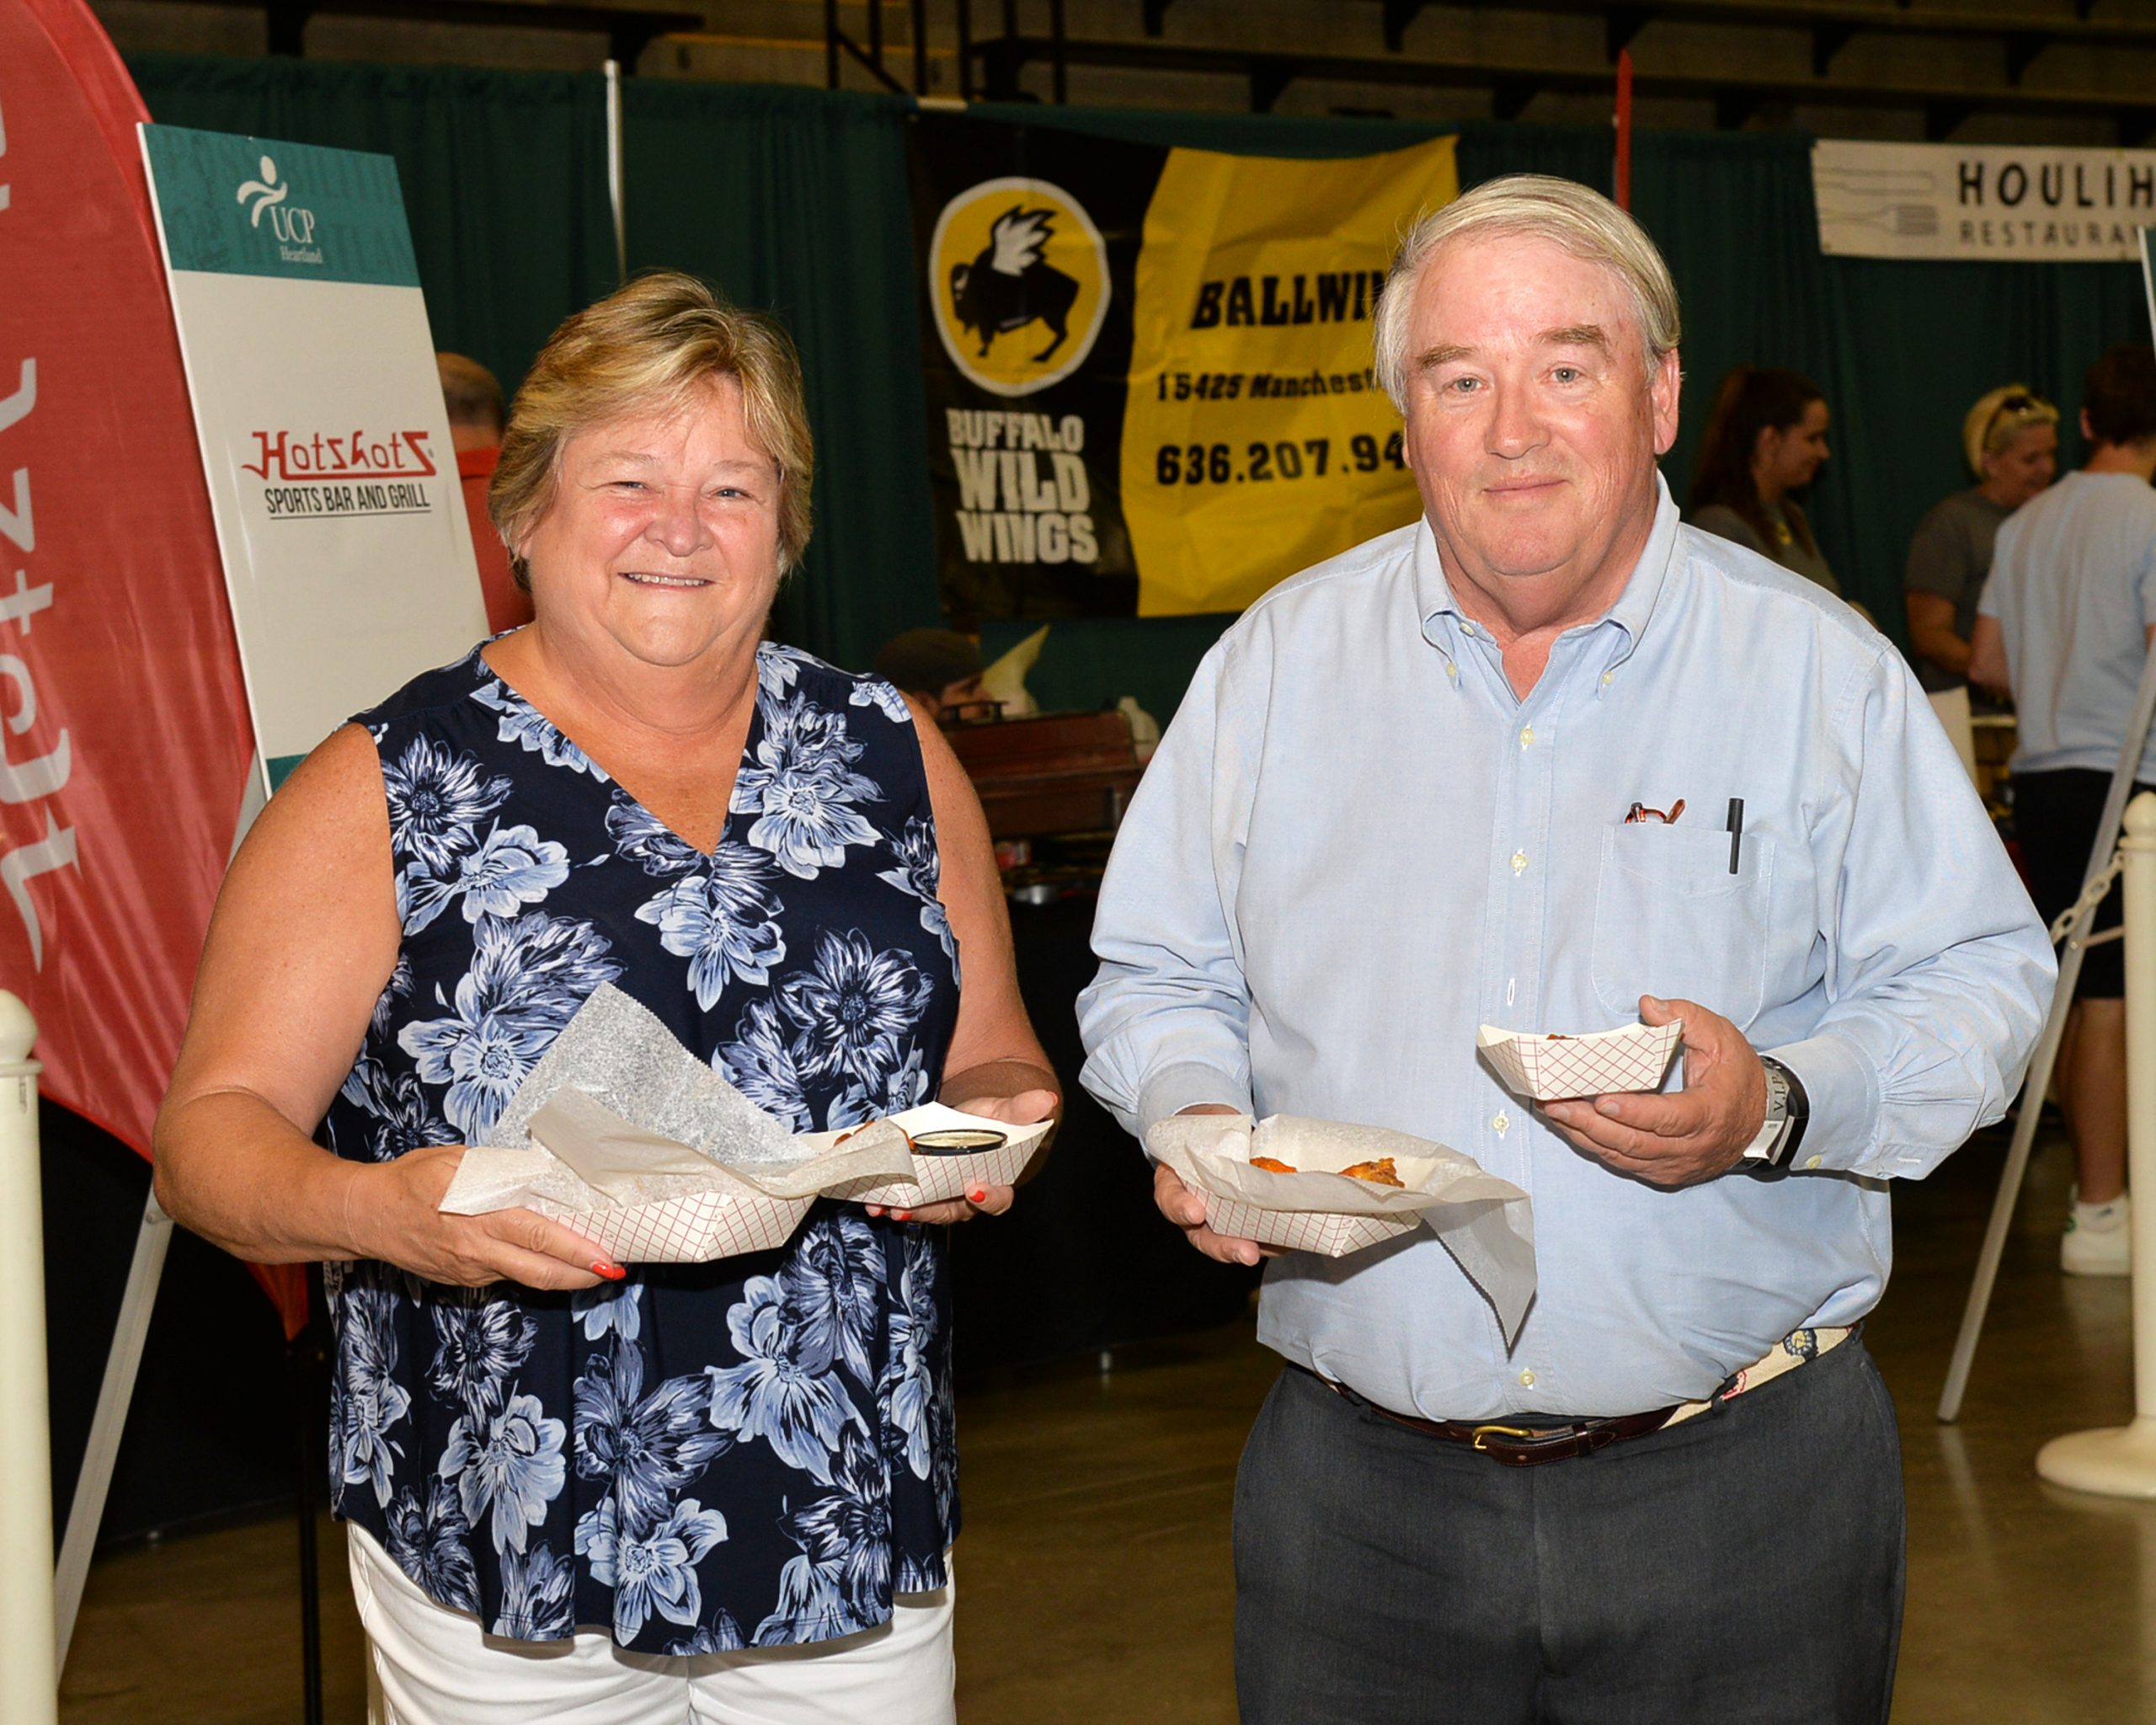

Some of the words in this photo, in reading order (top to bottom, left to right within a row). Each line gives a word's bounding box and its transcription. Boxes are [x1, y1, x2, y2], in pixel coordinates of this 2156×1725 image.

[1959, 163, 2155, 207] HOULIH
[270, 206, 315, 244] UCP
[945, 408, 1085, 453] BUFFALO
[264, 486, 323, 515] SPORTS
[323, 485, 355, 512] BAR
[356, 484, 387, 510] AND
[388, 483, 430, 508] GRILL
[949, 446, 1091, 513] WILD
[955, 510, 1099, 563] WINGS
